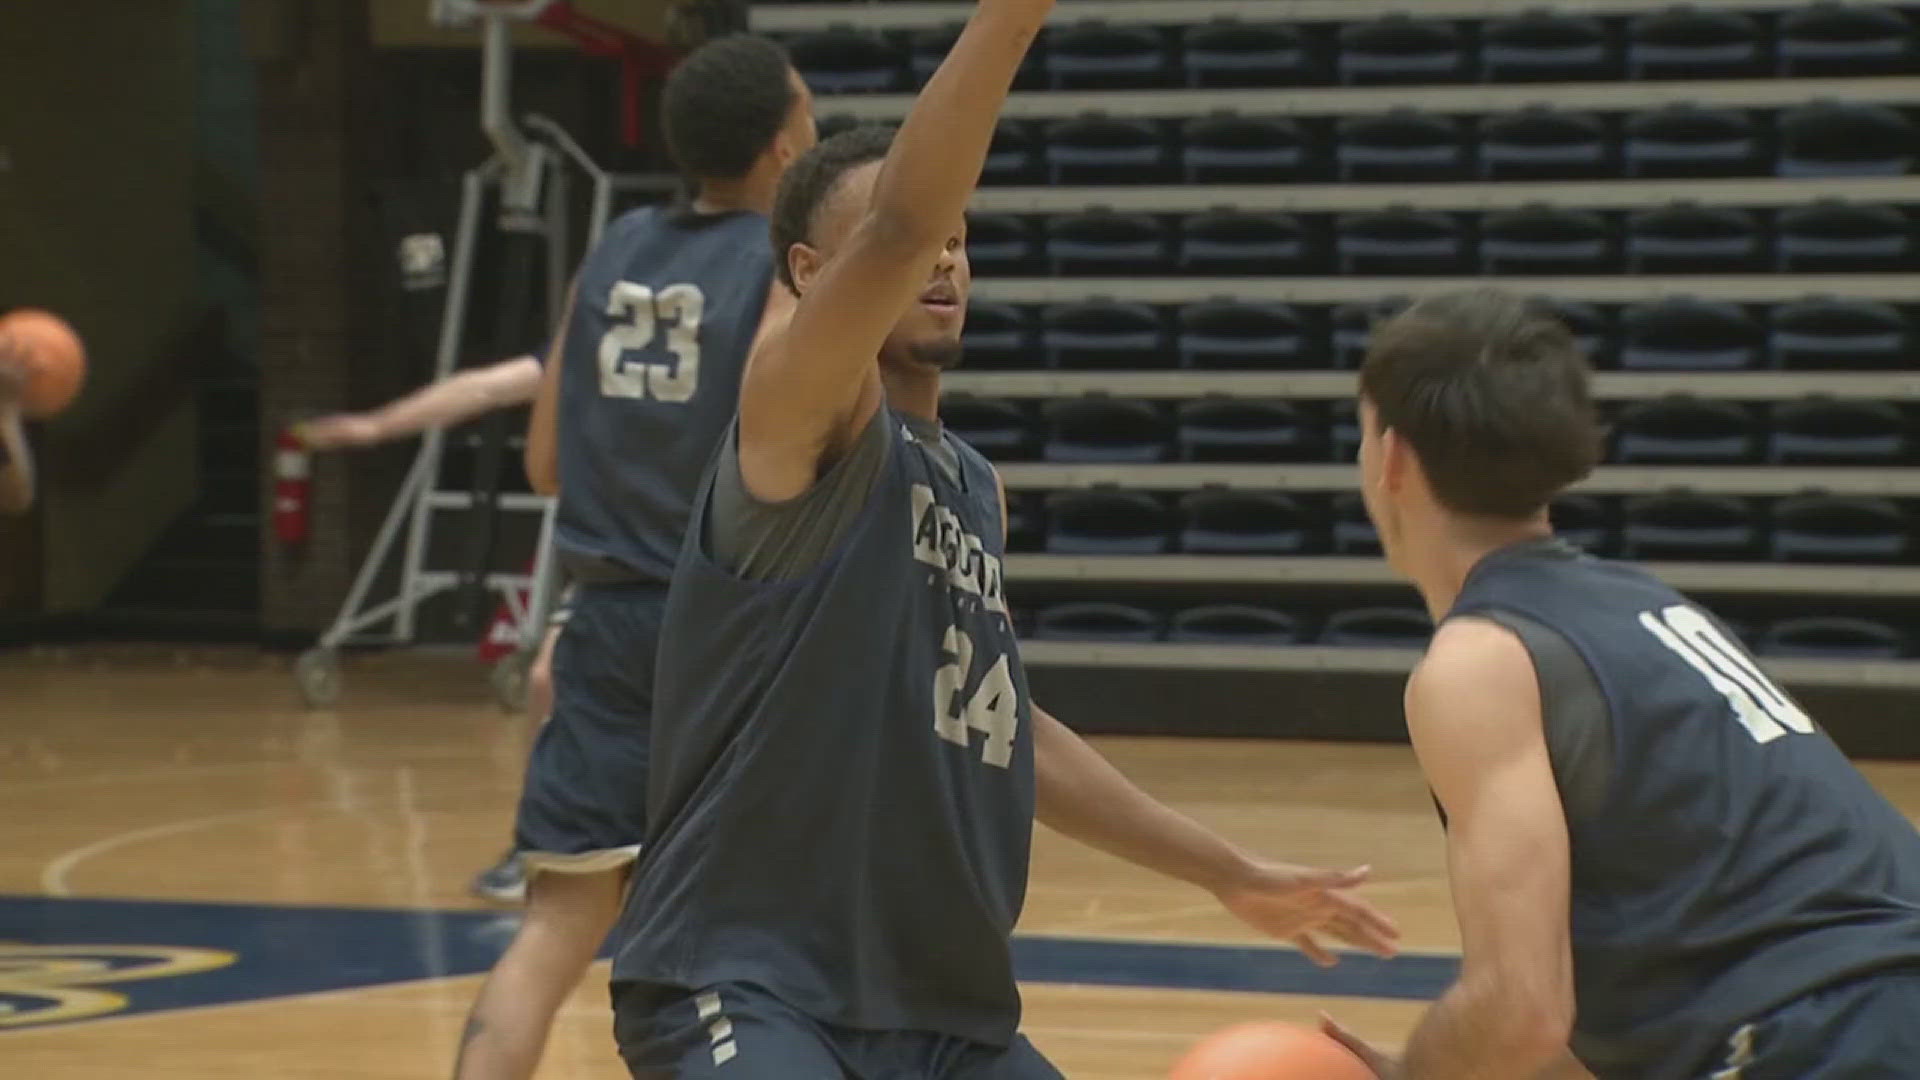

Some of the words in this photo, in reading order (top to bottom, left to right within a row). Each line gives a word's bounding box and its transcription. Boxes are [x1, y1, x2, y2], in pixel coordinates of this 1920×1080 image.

[599, 280, 704, 402] 23
[934, 624, 1018, 769] 24
[1638, 604, 1815, 744] 10
